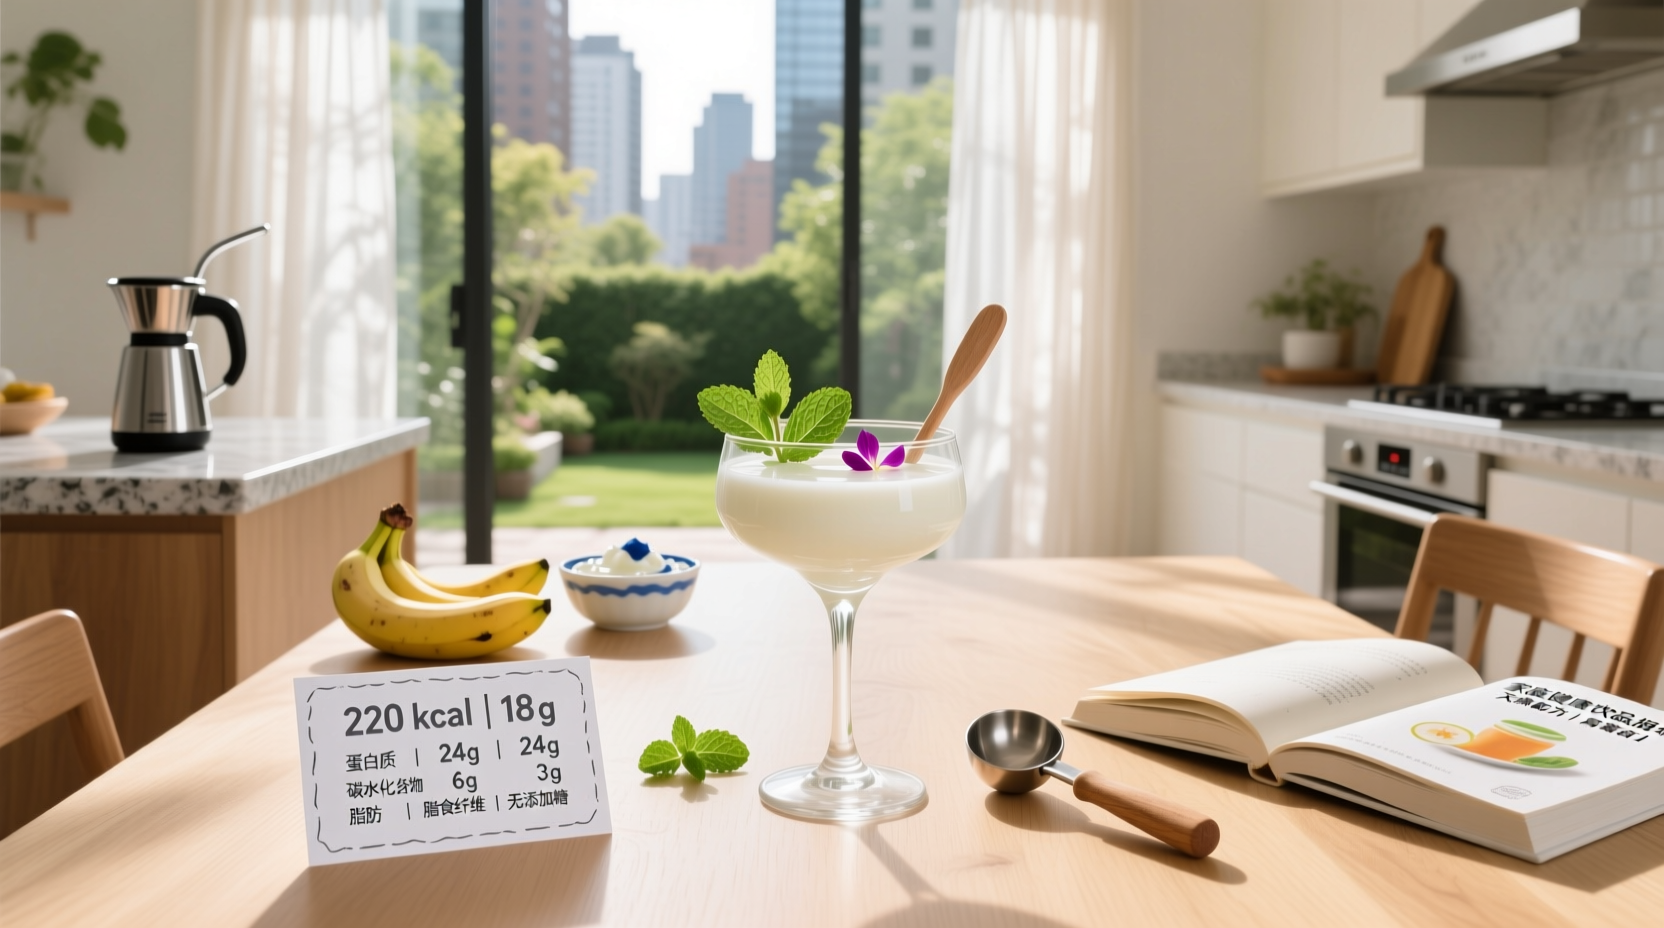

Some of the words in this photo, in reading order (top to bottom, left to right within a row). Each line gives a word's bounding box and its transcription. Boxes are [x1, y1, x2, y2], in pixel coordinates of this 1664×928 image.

[343, 703, 404, 737] 220
[411, 696, 473, 731] kcal
[500, 693, 556, 728] 18g
[345, 750, 397, 773] 蛋白质
[438, 742, 481, 766] 24g
[519, 735, 560, 759] 24g
[452, 770, 479, 794] 6g
[536, 763, 563, 785] 3g
[348, 804, 383, 826] 脂肪
